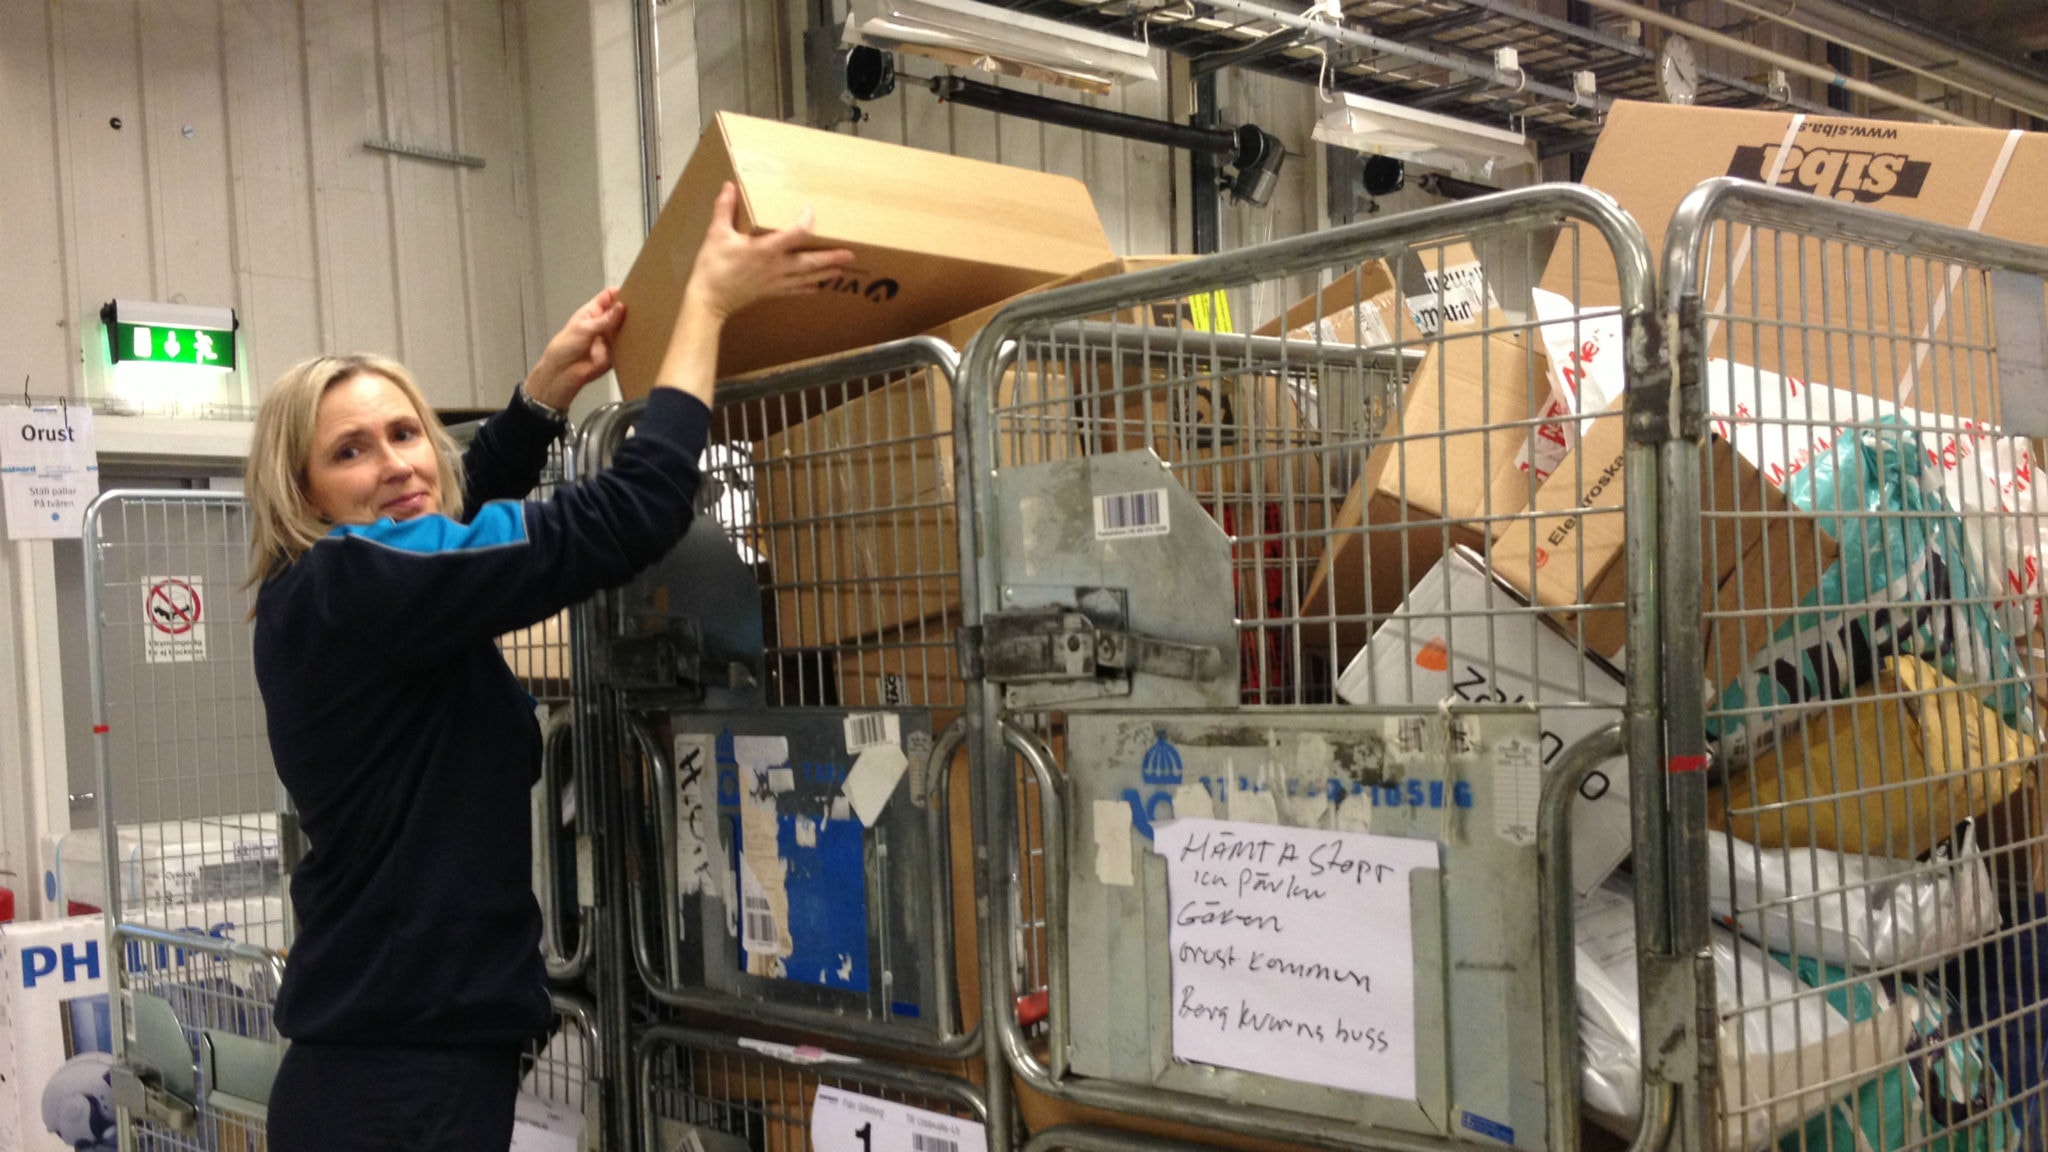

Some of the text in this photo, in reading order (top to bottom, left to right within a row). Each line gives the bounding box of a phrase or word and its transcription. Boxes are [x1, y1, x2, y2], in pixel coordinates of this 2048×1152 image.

[1786, 122, 1898, 140] www.siba.s
[1759, 143, 1910, 205] siba
[21, 424, 75, 442] Orust
[1548, 452, 1624, 548] Eleroska
[21, 922, 236, 988] PHLIPS
[855, 1120, 872, 1152] 1
